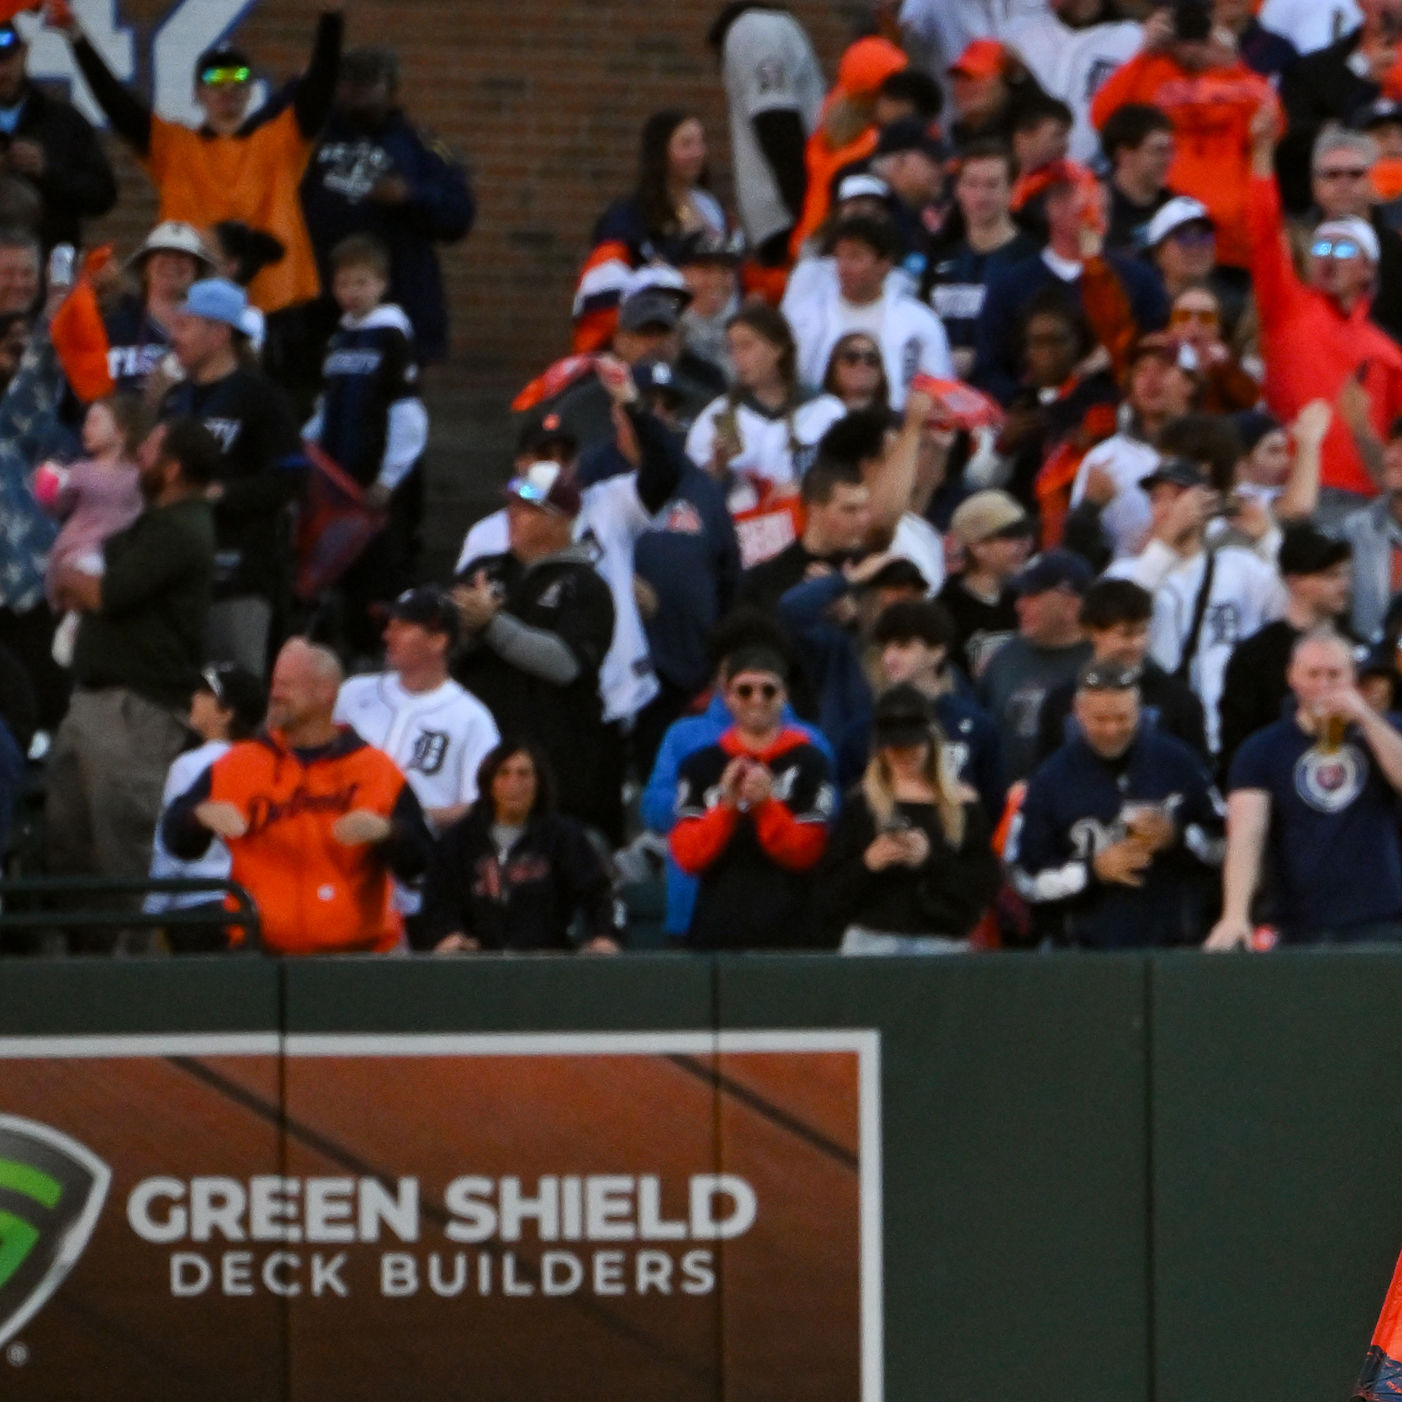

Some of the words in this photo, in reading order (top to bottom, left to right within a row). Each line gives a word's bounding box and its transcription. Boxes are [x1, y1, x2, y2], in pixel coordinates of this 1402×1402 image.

[408, 727, 450, 778] D
[128, 1176, 419, 1243] GREEN
[446, 1174, 757, 1243] SHIELD
[170, 1253, 347, 1297] DECK
[381, 1250, 715, 1297] BUILDERS
